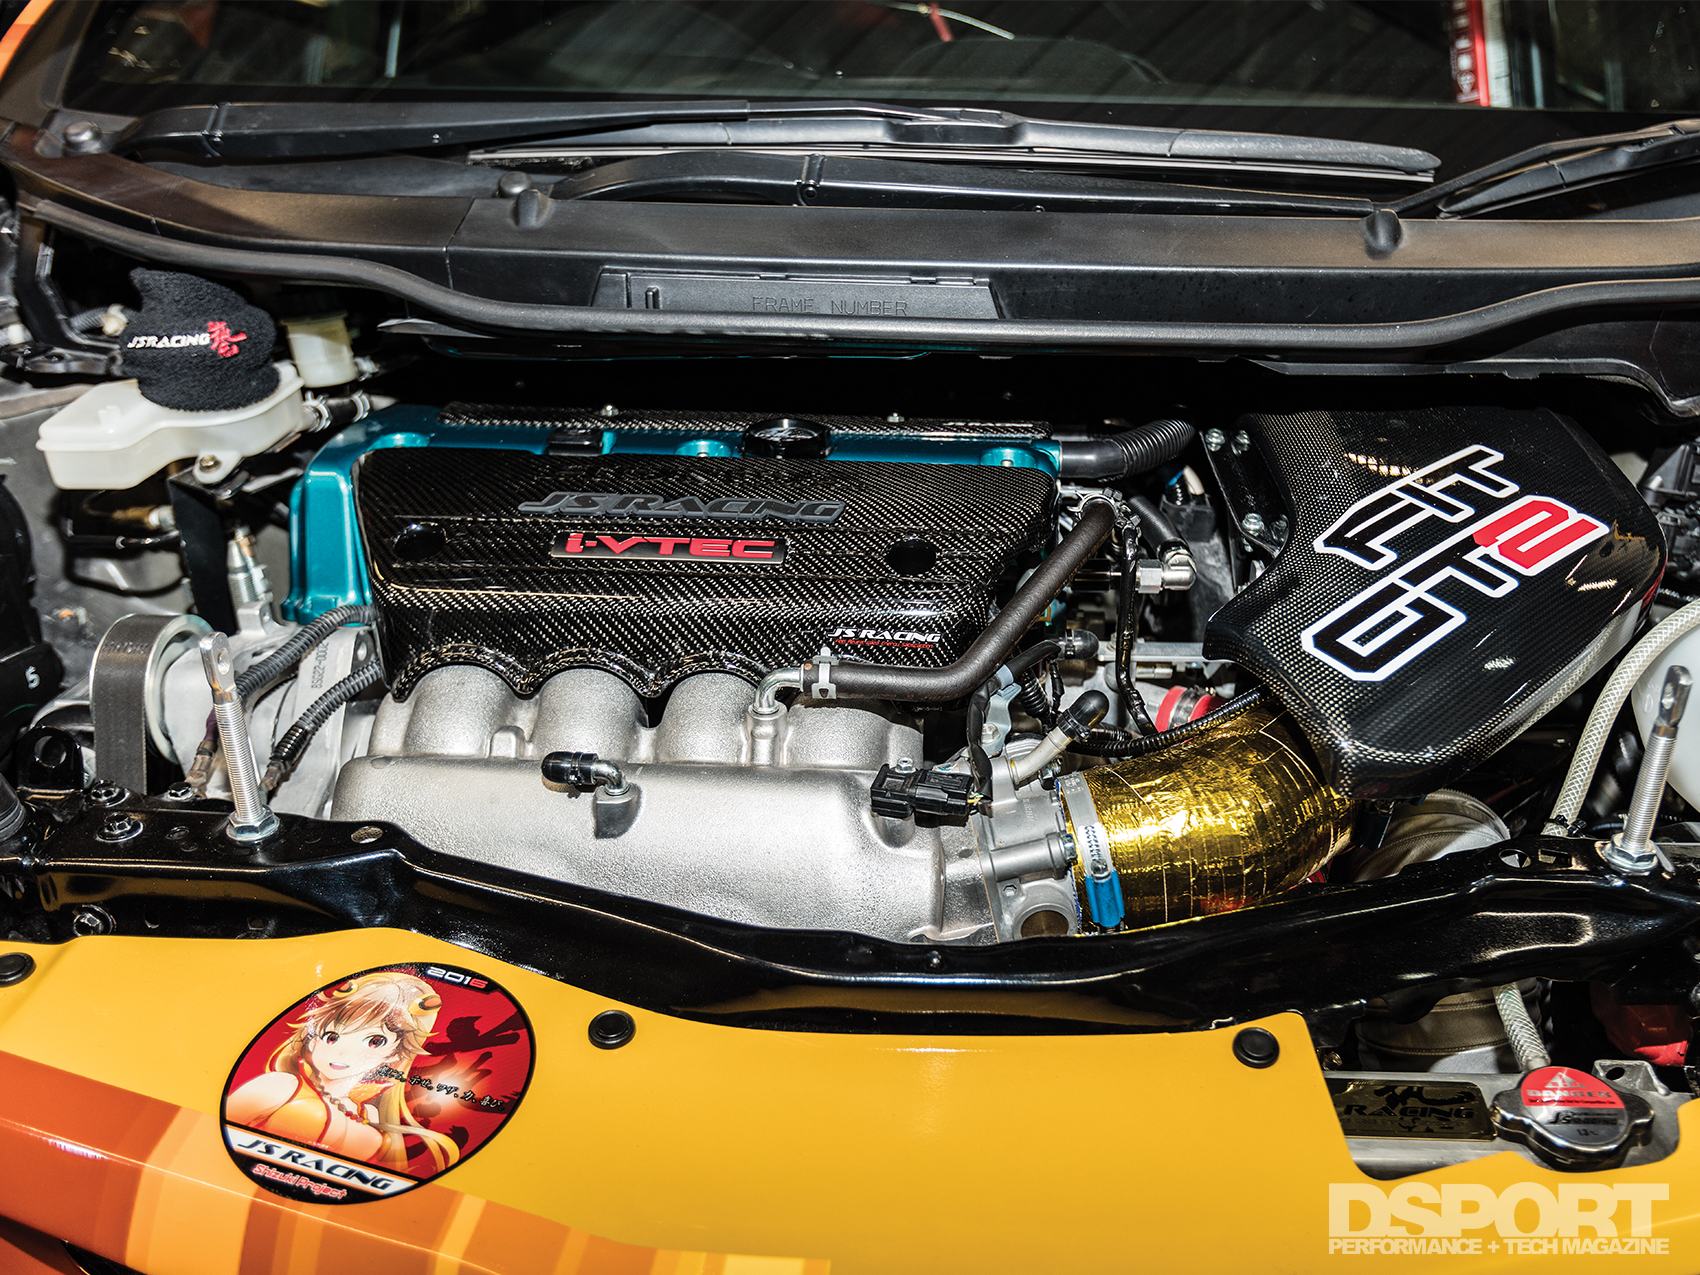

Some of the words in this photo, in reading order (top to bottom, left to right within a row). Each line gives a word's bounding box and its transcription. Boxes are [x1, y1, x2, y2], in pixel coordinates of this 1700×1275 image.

[752, 297, 814, 314] FRAME
[831, 300, 908, 316] NUMBER
[1314, 444, 1520, 571] FIT
[564, 533, 776, 559] i-VTEC
[1300, 494, 1610, 682] GT2
[858, 629, 941, 643] RACING
[1526, 1089, 1612, 1098] DANGER
[252, 1164, 298, 1186] Shizuki
[296, 1177, 348, 1200] Project
[279, 1149, 394, 1190] RACING
